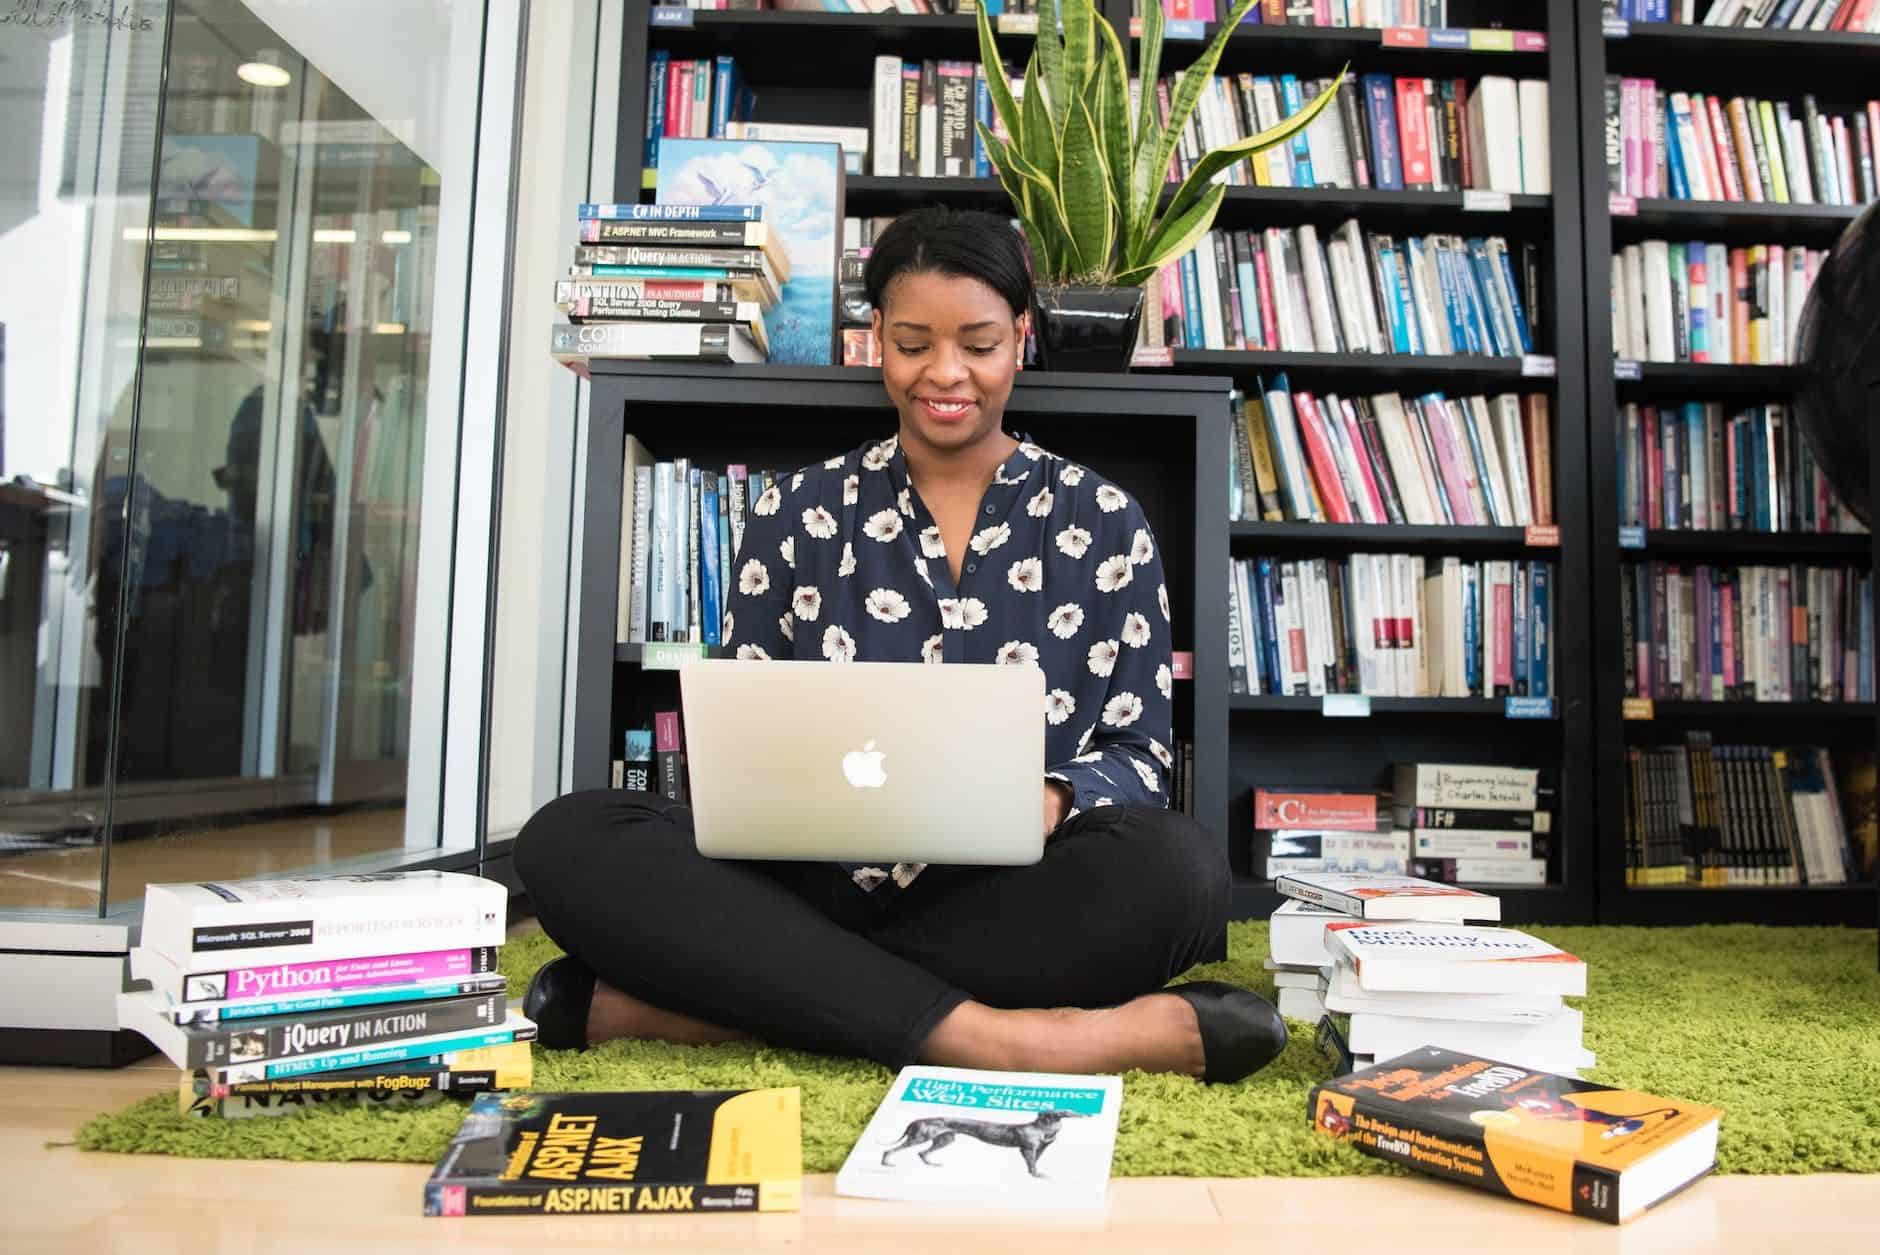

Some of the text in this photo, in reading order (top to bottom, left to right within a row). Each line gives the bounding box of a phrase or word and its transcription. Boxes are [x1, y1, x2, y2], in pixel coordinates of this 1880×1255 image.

[649, 205, 663, 218] IN
[664, 205, 700, 219] DEPTH
[648, 227, 669, 238] MVC
[669, 228, 717, 239] Framework
[625, 247, 665, 266] jQuery
[658, 299, 681, 310] Query
[236, 964, 331, 996] Python
[282, 1012, 427, 1053] jQuery IN ACTION
[320, 1055, 338, 1069] Up
[376, 1074, 432, 1093] FogBugz
[913, 1079, 1100, 1100] High Performance
[911, 1088, 1056, 1111] Web Sites
[527, 1112, 599, 1181] ASP.NET
[1355, 1113, 1370, 1129] The
[1415, 1130, 1484, 1161] Implementation
[584, 1135, 644, 1181] AJAX
[1377, 1134, 1411, 1155] FreeBSD
[1411, 1145, 1453, 1170] Operating
[1453, 1156, 1484, 1176] System
[544, 1187, 635, 1212] ASP.NET
[637, 1186, 695, 1212] AJAX
